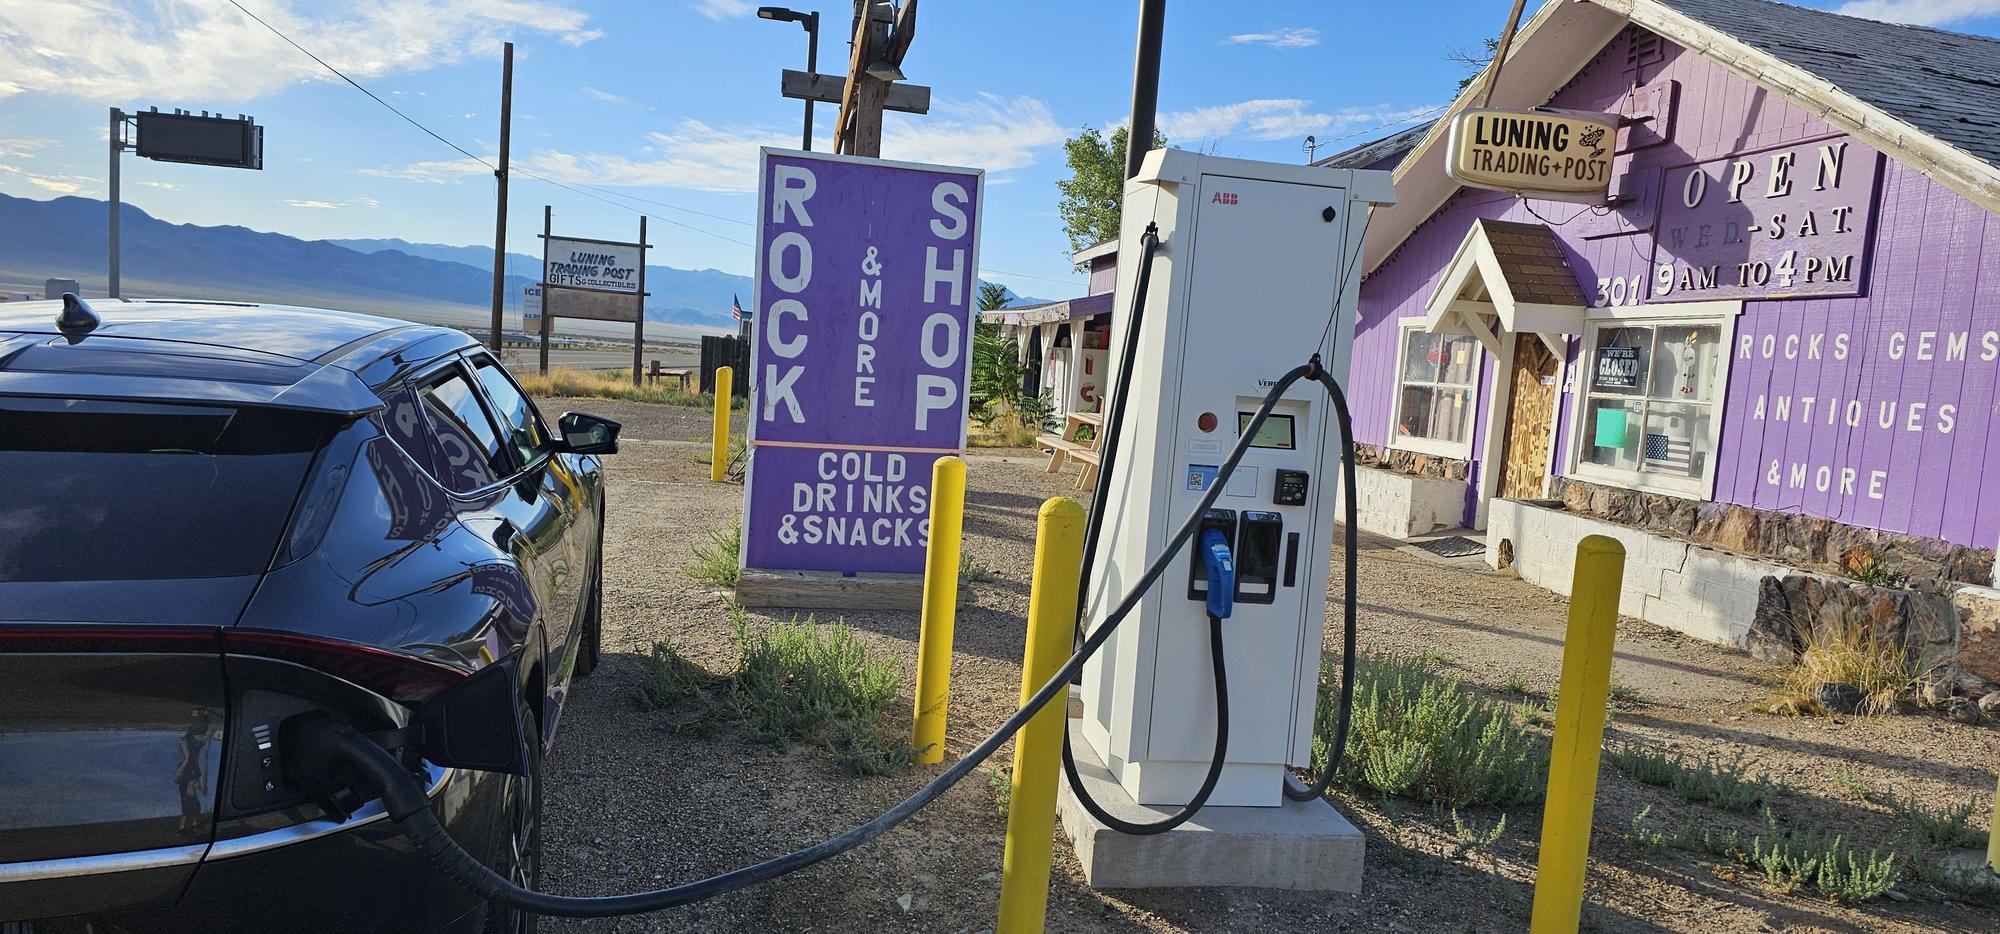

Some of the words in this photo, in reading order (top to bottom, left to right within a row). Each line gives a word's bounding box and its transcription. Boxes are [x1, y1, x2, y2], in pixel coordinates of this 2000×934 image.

[1475, 116, 1569, 152] LUNING
[1473, 149, 1550, 177] TRADING
[1563, 157, 1607, 182] POST
[1683, 142, 1848, 208] OPEN
[1211, 191, 1239, 205] ABB
[550, 262, 599, 277] TRADING
[602, 267, 636, 280] POST
[570, 251, 616, 266] LUNING
[524, 288, 541, 296] ICE
[549, 273, 582, 285] GIFTS
[587, 279, 636, 289] COLLECTIBLES
[763, 164, 817, 424] ROCK
[1595, 275, 1642, 308] 301
[1656, 262, 1719, 296] 9AM
[1738, 261, 1772, 287] TO
[914, 181, 969, 431] SHOP
[1607, 350, 1634, 358] WE'RE
[1739, 333, 1849, 361] ROCKS
[1888, 331, 1999, 362] GEMS
[1599, 357, 1638, 377] CLOSED
[1753, 394, 1956, 434] ANTIQUES
[818, 452, 906, 482] COLD
[793, 482, 927, 514] DRINKS
